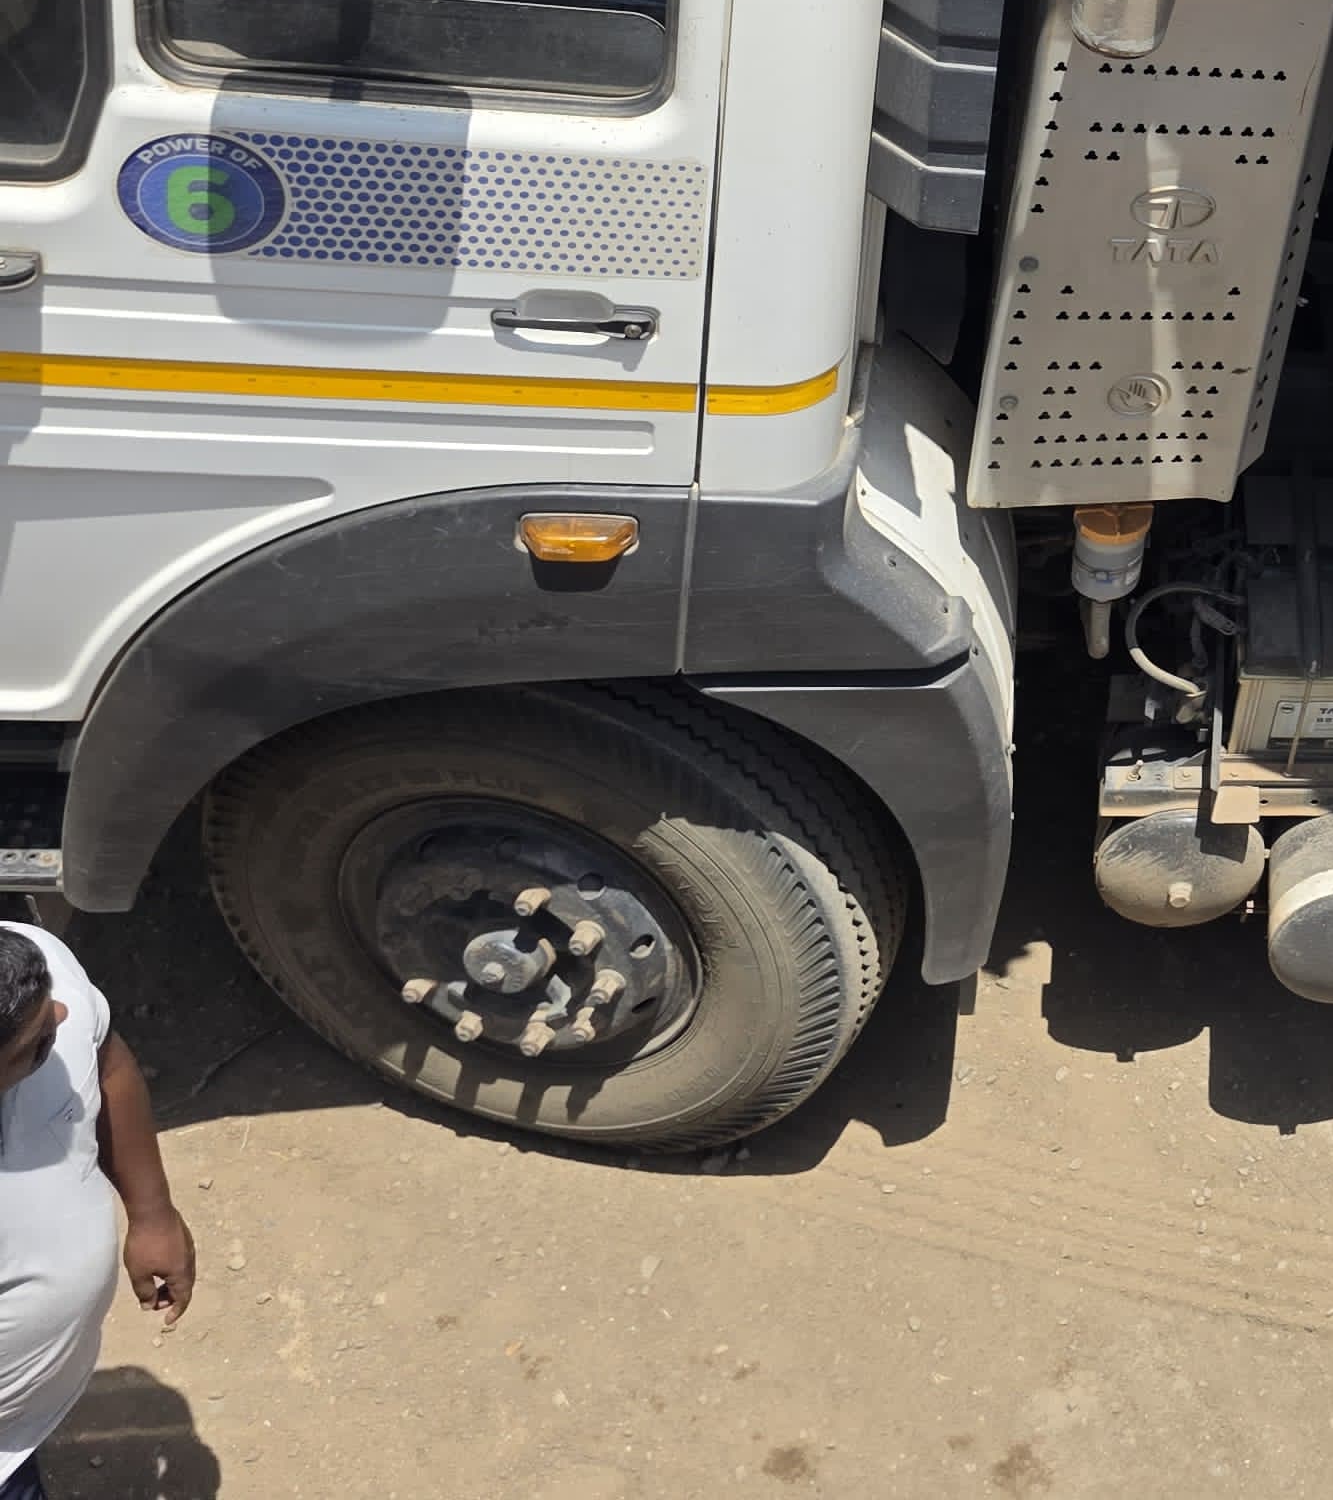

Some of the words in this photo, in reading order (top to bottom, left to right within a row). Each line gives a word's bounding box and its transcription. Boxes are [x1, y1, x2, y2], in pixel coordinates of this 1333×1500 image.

[136, 137, 227, 165] POWER
[229, 149, 264, 171] OF
[165, 164, 236, 236] 6
[1109, 237, 1221, 264] TATA
